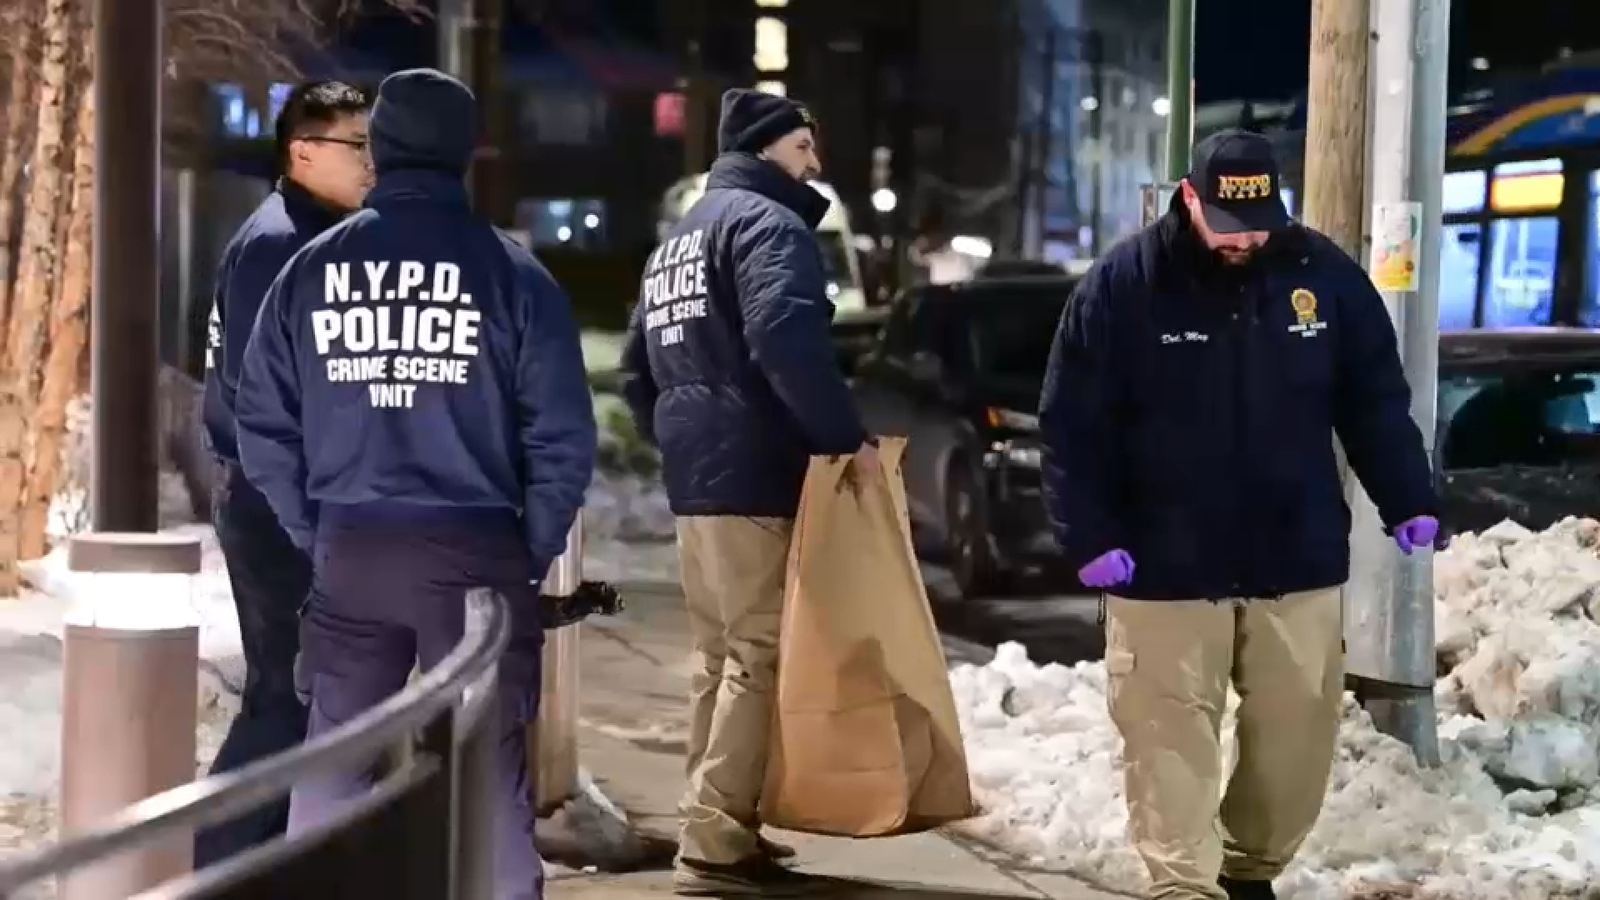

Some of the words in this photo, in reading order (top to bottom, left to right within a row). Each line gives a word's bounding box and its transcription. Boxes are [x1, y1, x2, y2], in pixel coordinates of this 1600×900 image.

[324, 260, 474, 304] N.Y.P.D.
[645, 260, 707, 311] POLICE
[311, 305, 482, 355] POLICE
[326, 356, 388, 382] CRIME
[392, 356, 470, 384] SCENE
